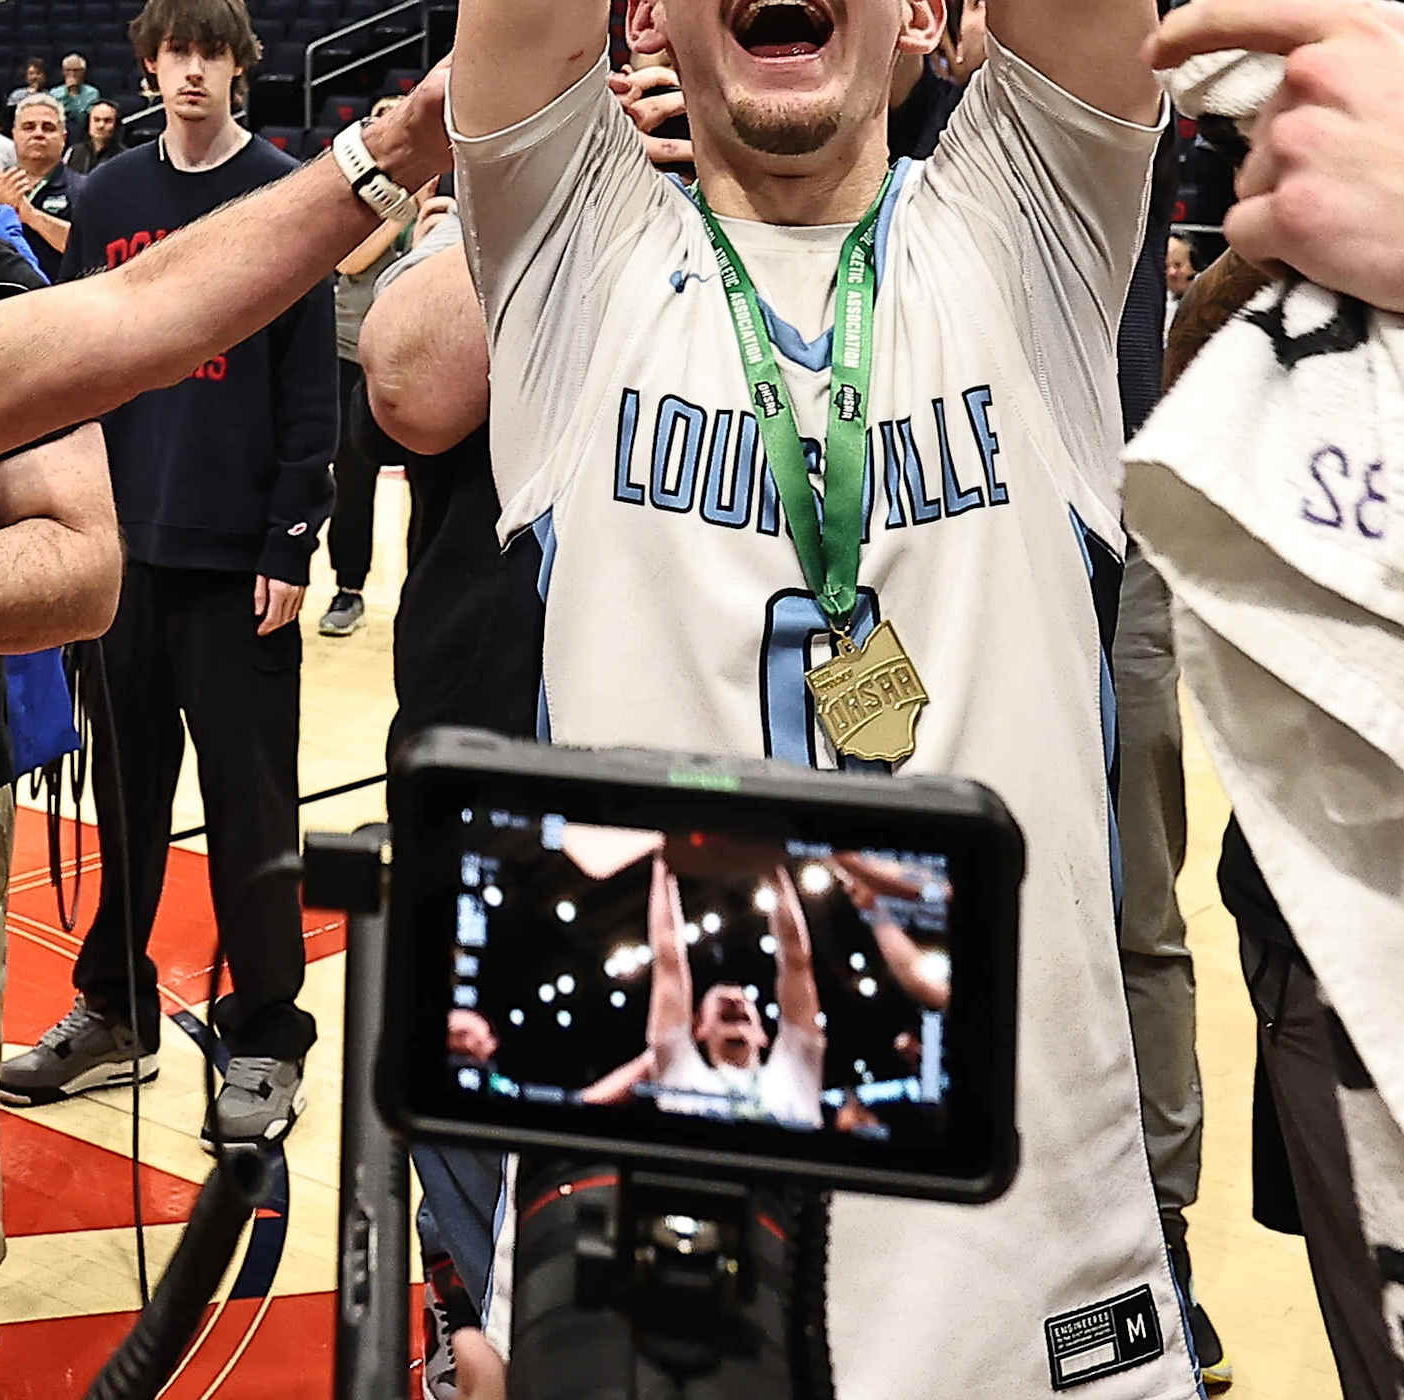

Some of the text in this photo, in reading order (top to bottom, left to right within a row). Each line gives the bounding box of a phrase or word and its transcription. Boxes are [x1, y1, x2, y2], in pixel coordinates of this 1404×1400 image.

[714, 246, 764, 366] ATHLETIC ASSOCIATION
[843, 290, 863, 369] ASSOCIATION
[757, 383, 778, 418] OHSAA
[841, 384, 855, 421] OHSAA
[825, 663, 917, 735] OHSAA
[1126, 1312, 1147, 1344] M
